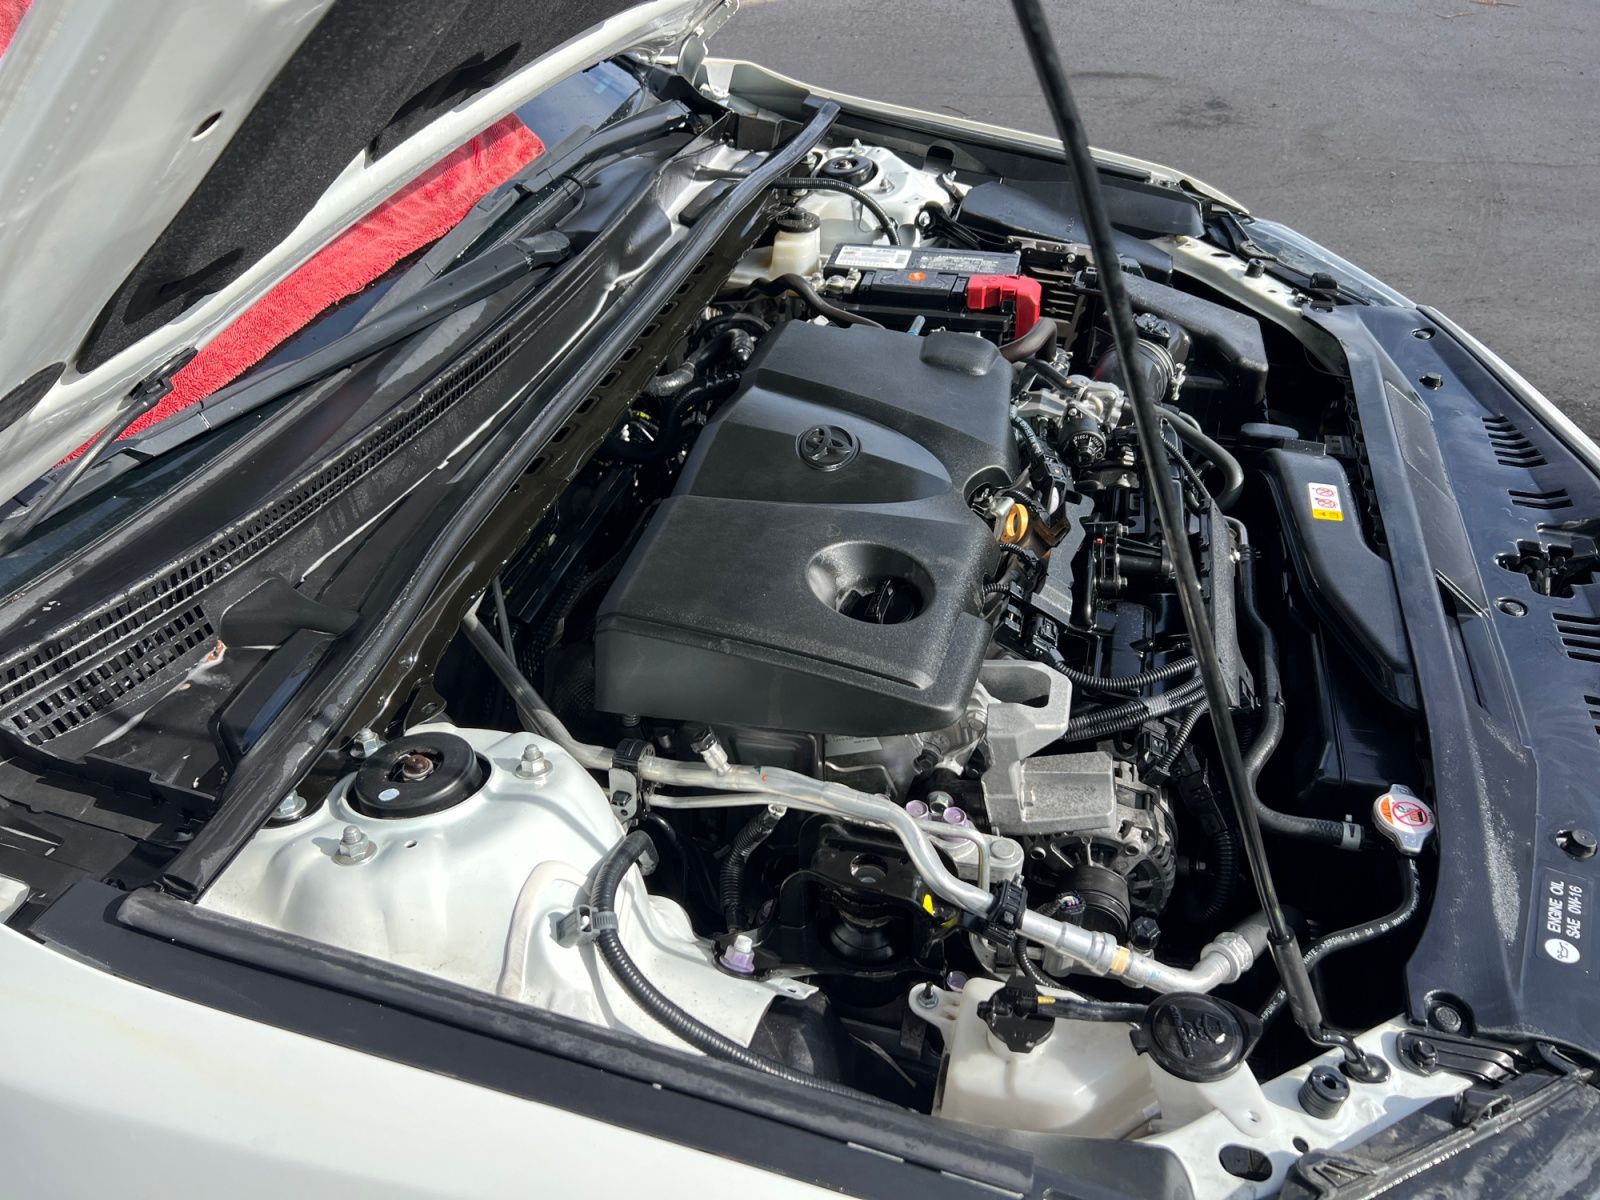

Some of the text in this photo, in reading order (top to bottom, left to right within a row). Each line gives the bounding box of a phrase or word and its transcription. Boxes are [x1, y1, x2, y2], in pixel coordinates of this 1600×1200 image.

[1547, 881, 1565, 933] ENGINE OIL
[1566, 885, 1583, 939] SAE 0W-16
